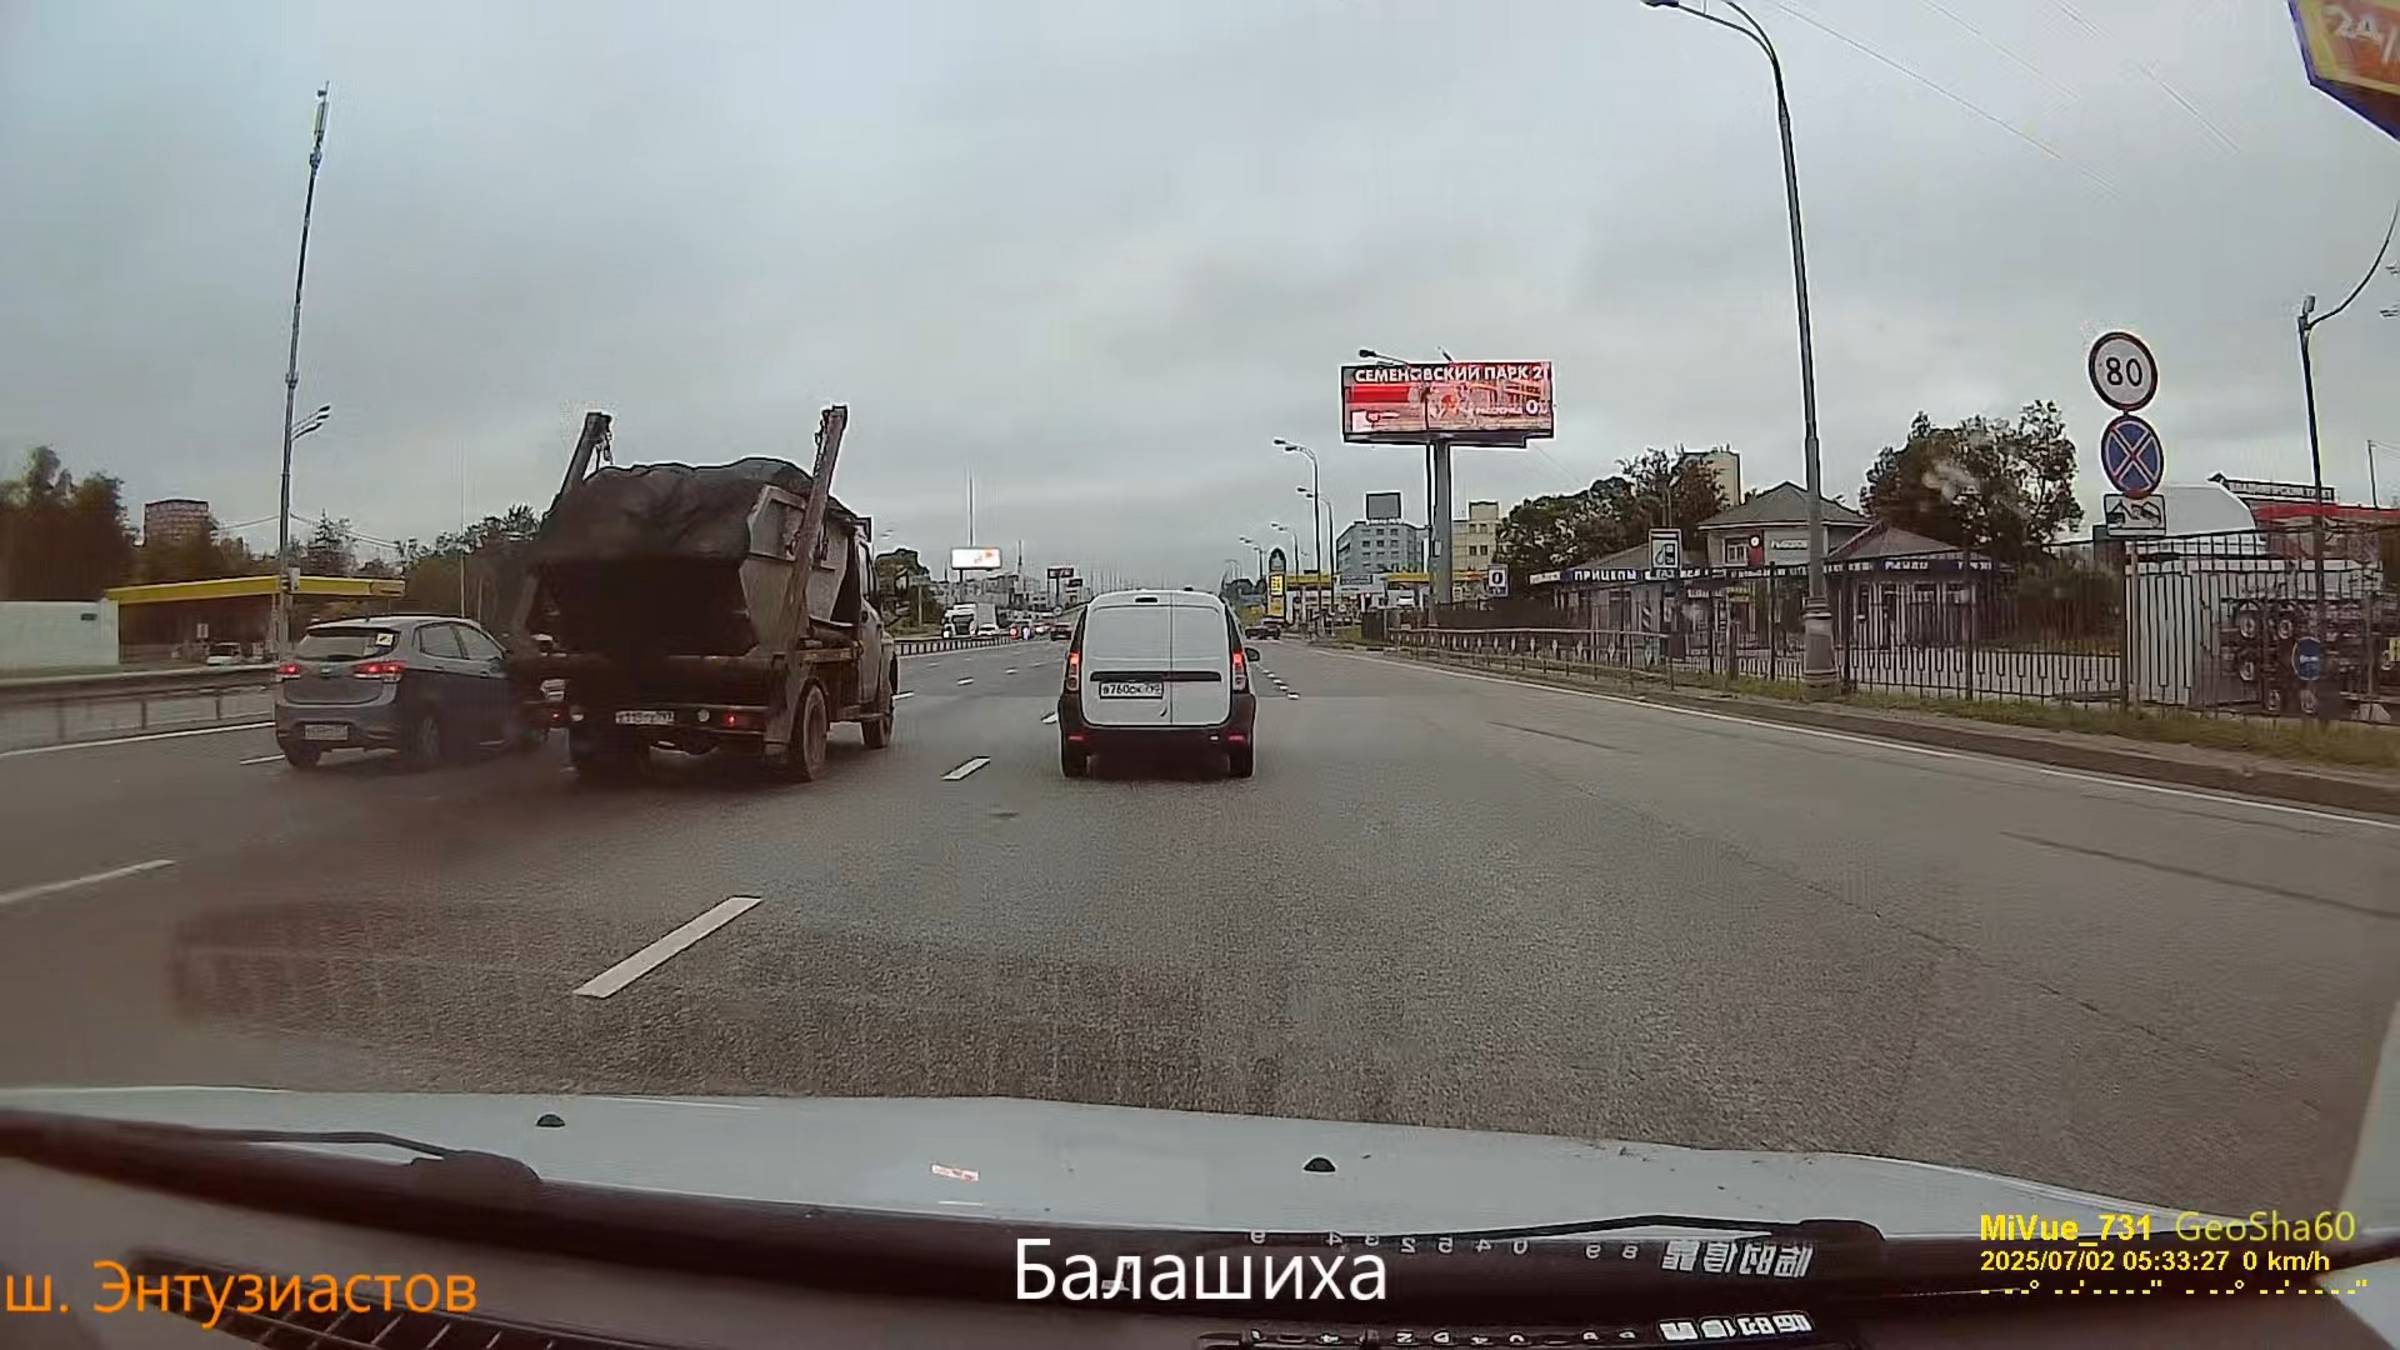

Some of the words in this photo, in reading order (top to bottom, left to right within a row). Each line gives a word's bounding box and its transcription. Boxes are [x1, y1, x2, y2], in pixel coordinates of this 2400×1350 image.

[1355, 365, 1480, 382] СЕМЕНОВСКИЙ
[1484, 365, 1529, 381] ПАРК
[2105, 356, 2143, 387] 80
[1574, 569, 1638, 582] ПРИЦЕПЫ
